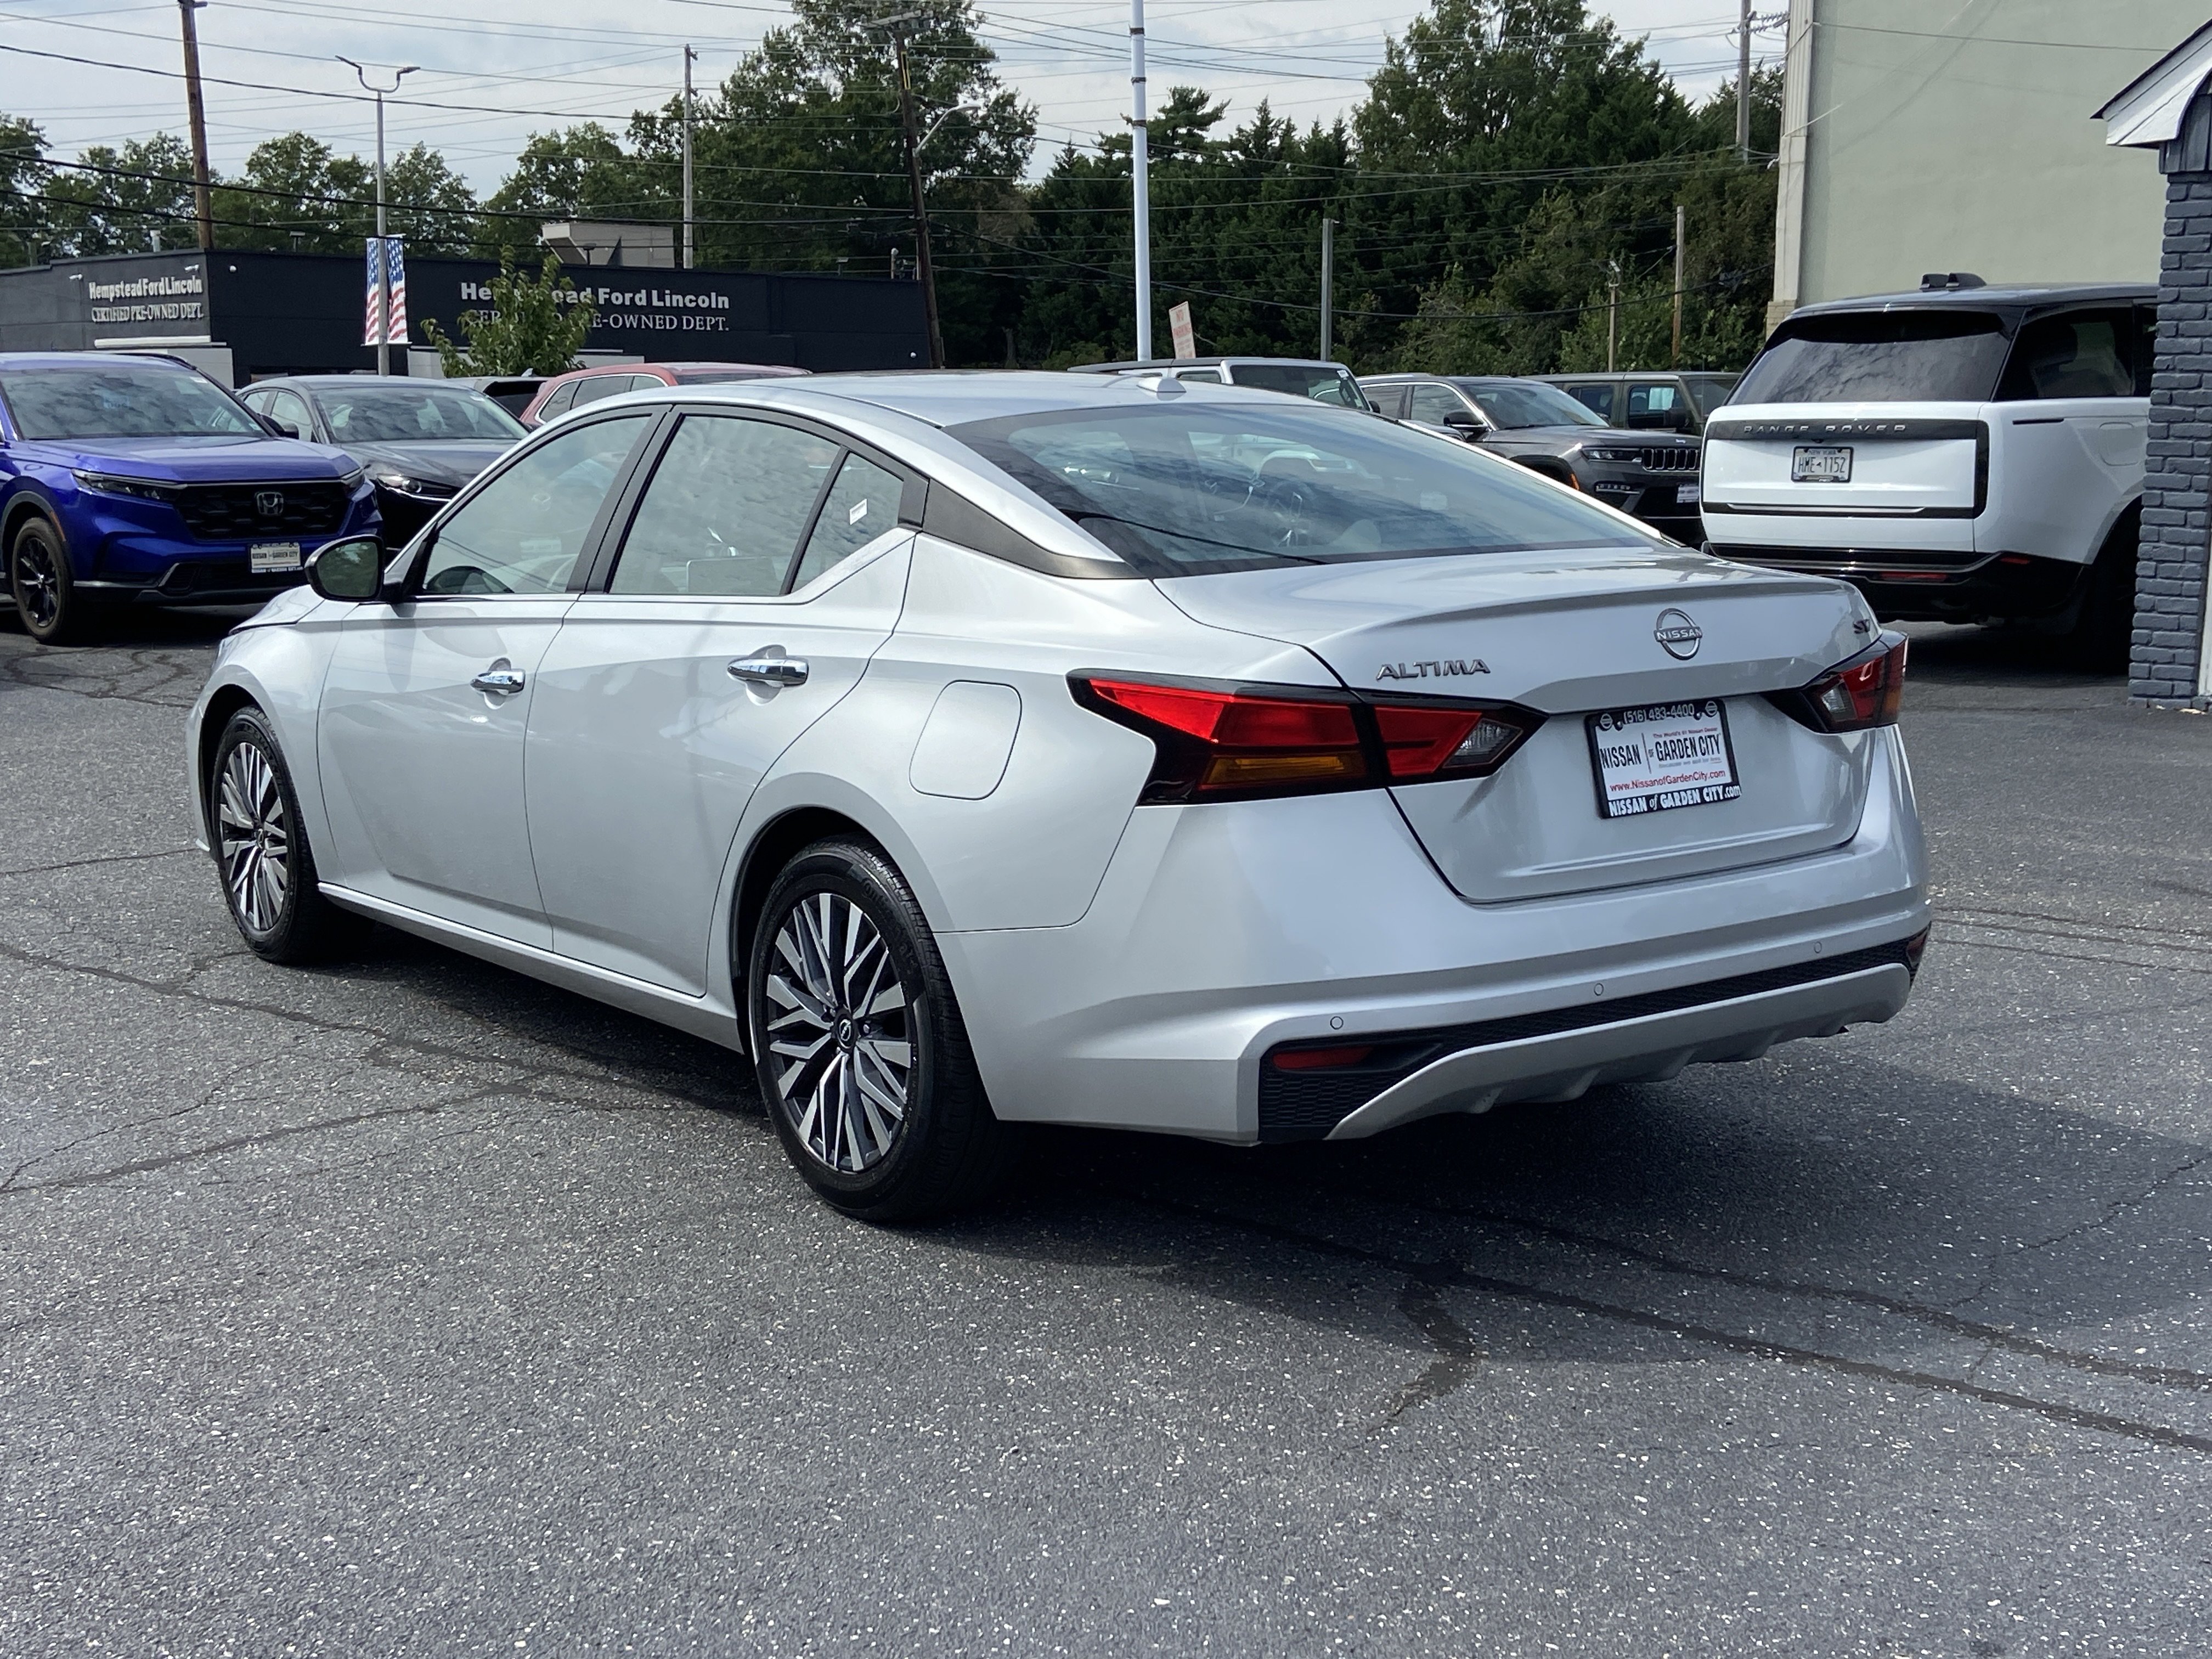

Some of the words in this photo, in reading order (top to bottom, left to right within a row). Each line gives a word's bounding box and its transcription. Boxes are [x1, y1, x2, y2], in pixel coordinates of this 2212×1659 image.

[461, 283, 592, 303] Heead
[598, 288, 647, 306] Ford
[651, 290, 729, 308] Lincoln
[573, 313, 678, 329] E-OWNED
[682, 315, 729, 331] DEPT.
[1656, 628, 1701, 640] NISSAN
[1376, 659, 1491, 681] ALTIMA
[1623, 709, 1646, 724] (516)
[1649, 703, 1695, 720] 483-4400
[1600, 744, 1641, 769] NISSAN
[1655, 737, 1698, 761] GARDEN
[1699, 734, 1720, 757] CITY
[1610, 769, 1726, 792] www.NissanofGardenCity.com
[1609, 797, 1647, 817] NISSAN
[1649, 794, 1658, 810] of
[1660, 788, 1701, 809] GARDEN
